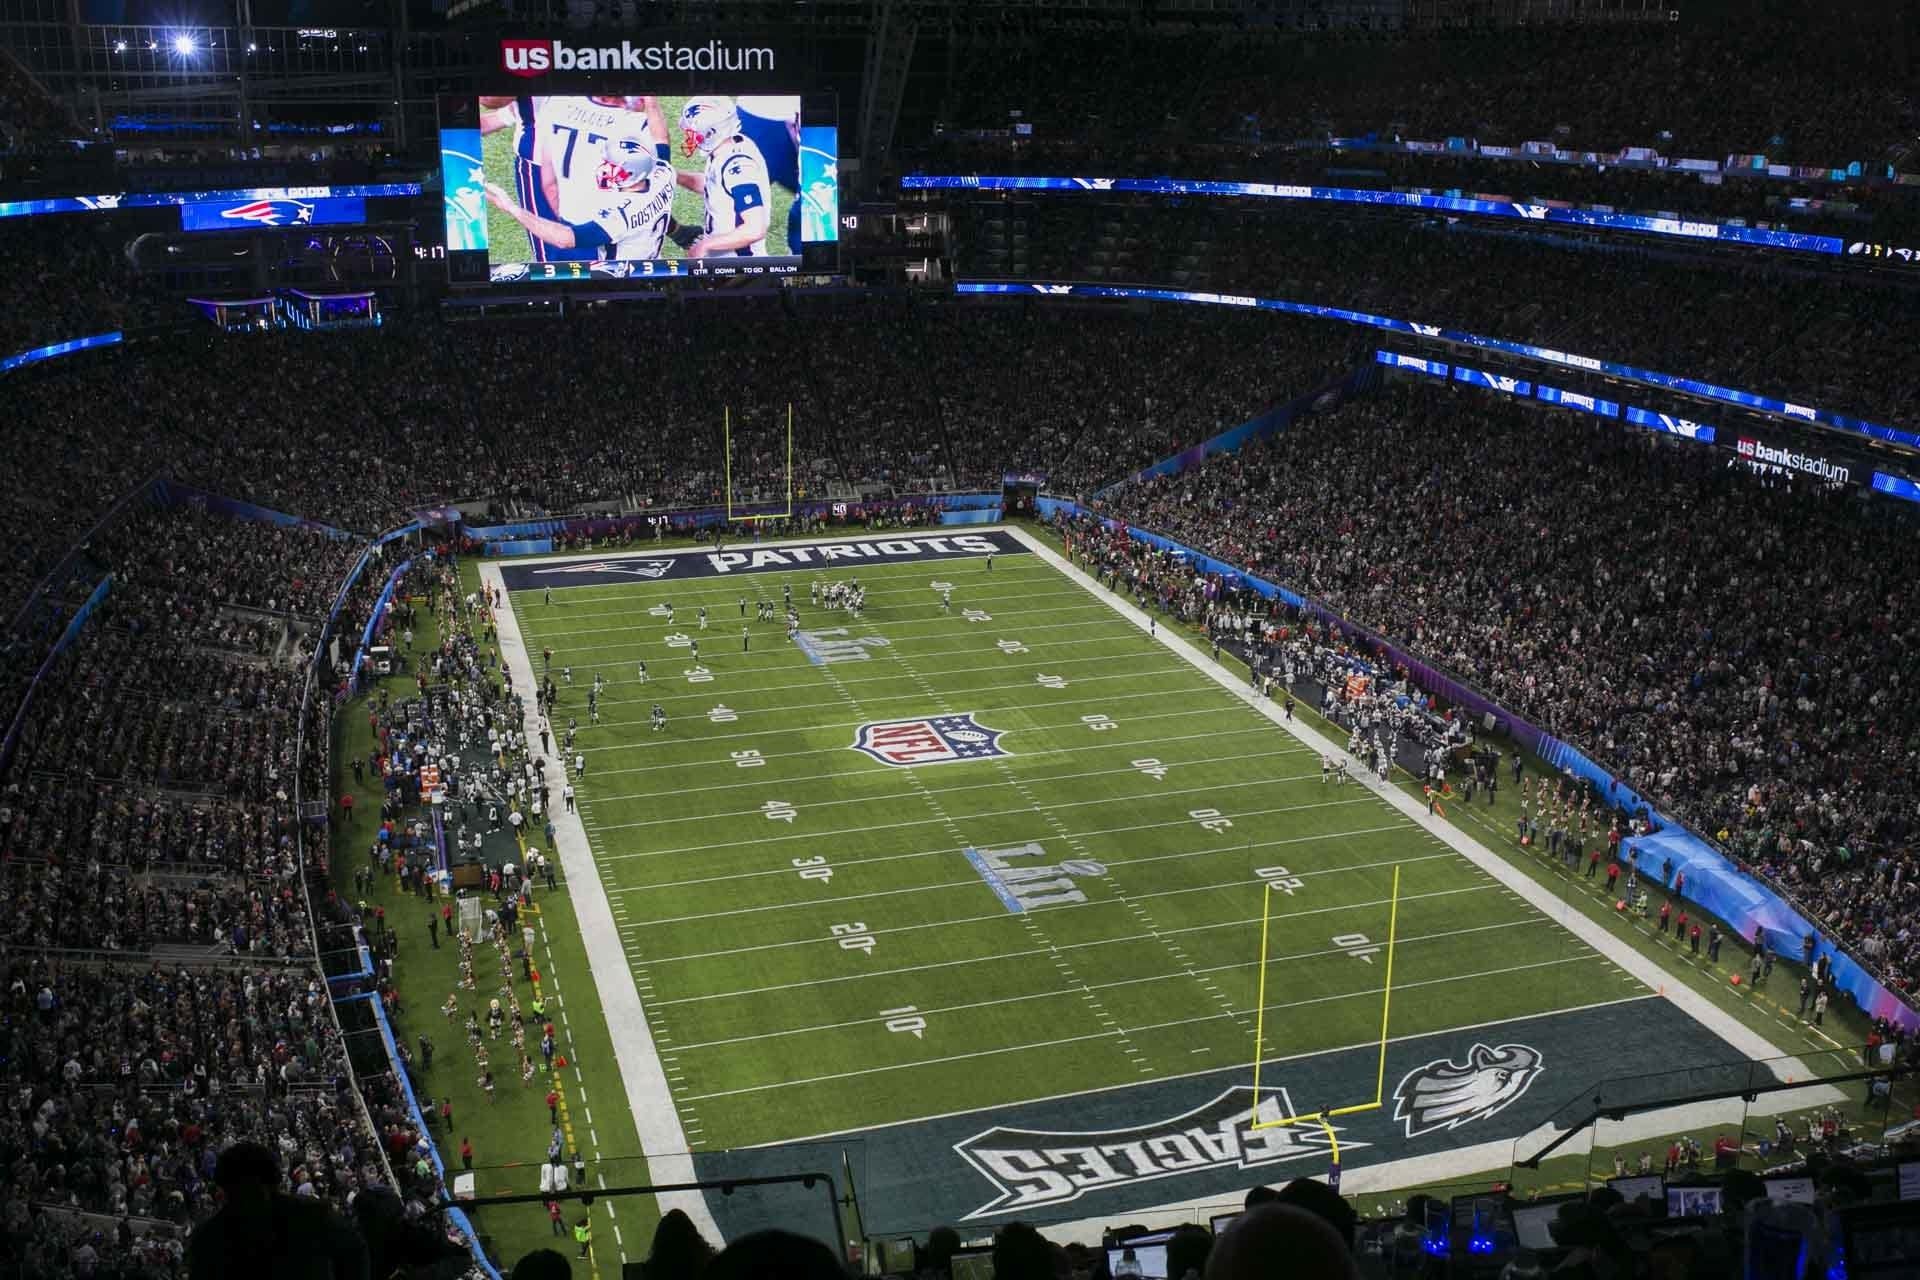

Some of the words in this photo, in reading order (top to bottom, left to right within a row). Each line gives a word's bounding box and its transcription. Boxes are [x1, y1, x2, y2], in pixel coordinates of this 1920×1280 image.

[841, 216, 857, 229] 40
[415, 246, 444, 259] 4:17
[544, 264, 556, 278] 3
[644, 262, 654, 275] 3
[648, 515, 669, 526] 4:17
[706, 535, 1000, 573] PATRIOTS
[1080, 714, 1119, 731] 50
[873, 723, 949, 761] NFL
[730, 749, 766, 768] 50
[1130, 758, 1168, 775] 40
[760, 800, 798, 820] 40
[1188, 808, 1233, 829] 30
[792, 855, 833, 879] 30
[1255, 866, 1305, 890] 20
[830, 922, 876, 950] 20
[1331, 933, 1381, 957] 10
[879, 1005, 927, 1033] 10
[971, 1095, 1322, 1202] EAGLES
